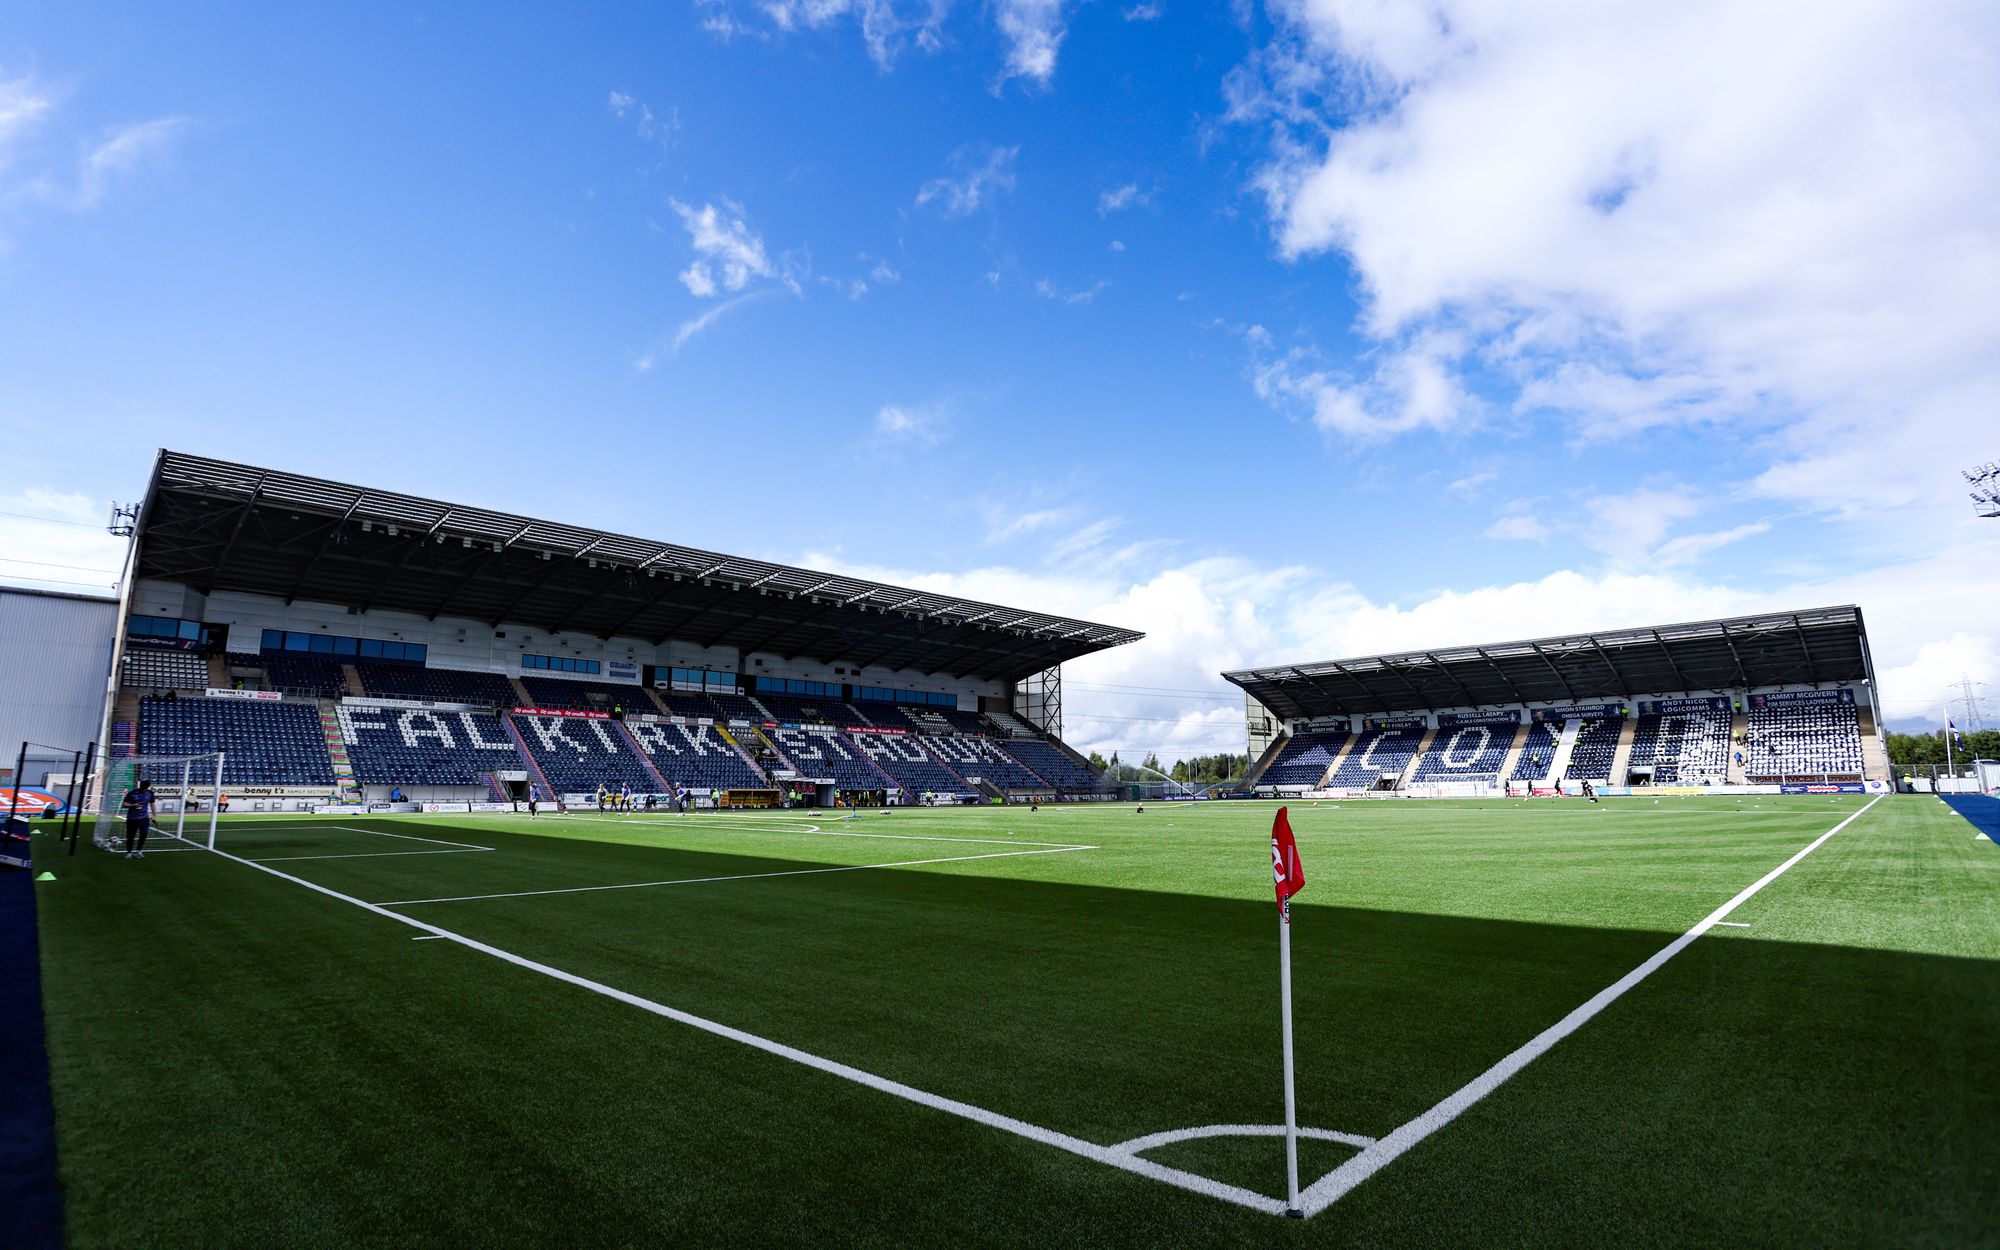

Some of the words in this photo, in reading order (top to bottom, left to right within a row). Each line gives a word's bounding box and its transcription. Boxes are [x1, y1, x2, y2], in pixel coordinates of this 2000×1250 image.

[1766, 692, 1796, 701] SAMMY
[1796, 690, 1838, 699] MCGIVERN
[1662, 699, 1683, 707] ANDY
[1685, 698, 1709, 706] NICOL
[1575, 704, 1605, 712] STAINROD
[1662, 704, 1711, 713] LOGICOMMS
[335, 705, 735, 757] FALKIRK
[244, 787, 271, 795] benny
